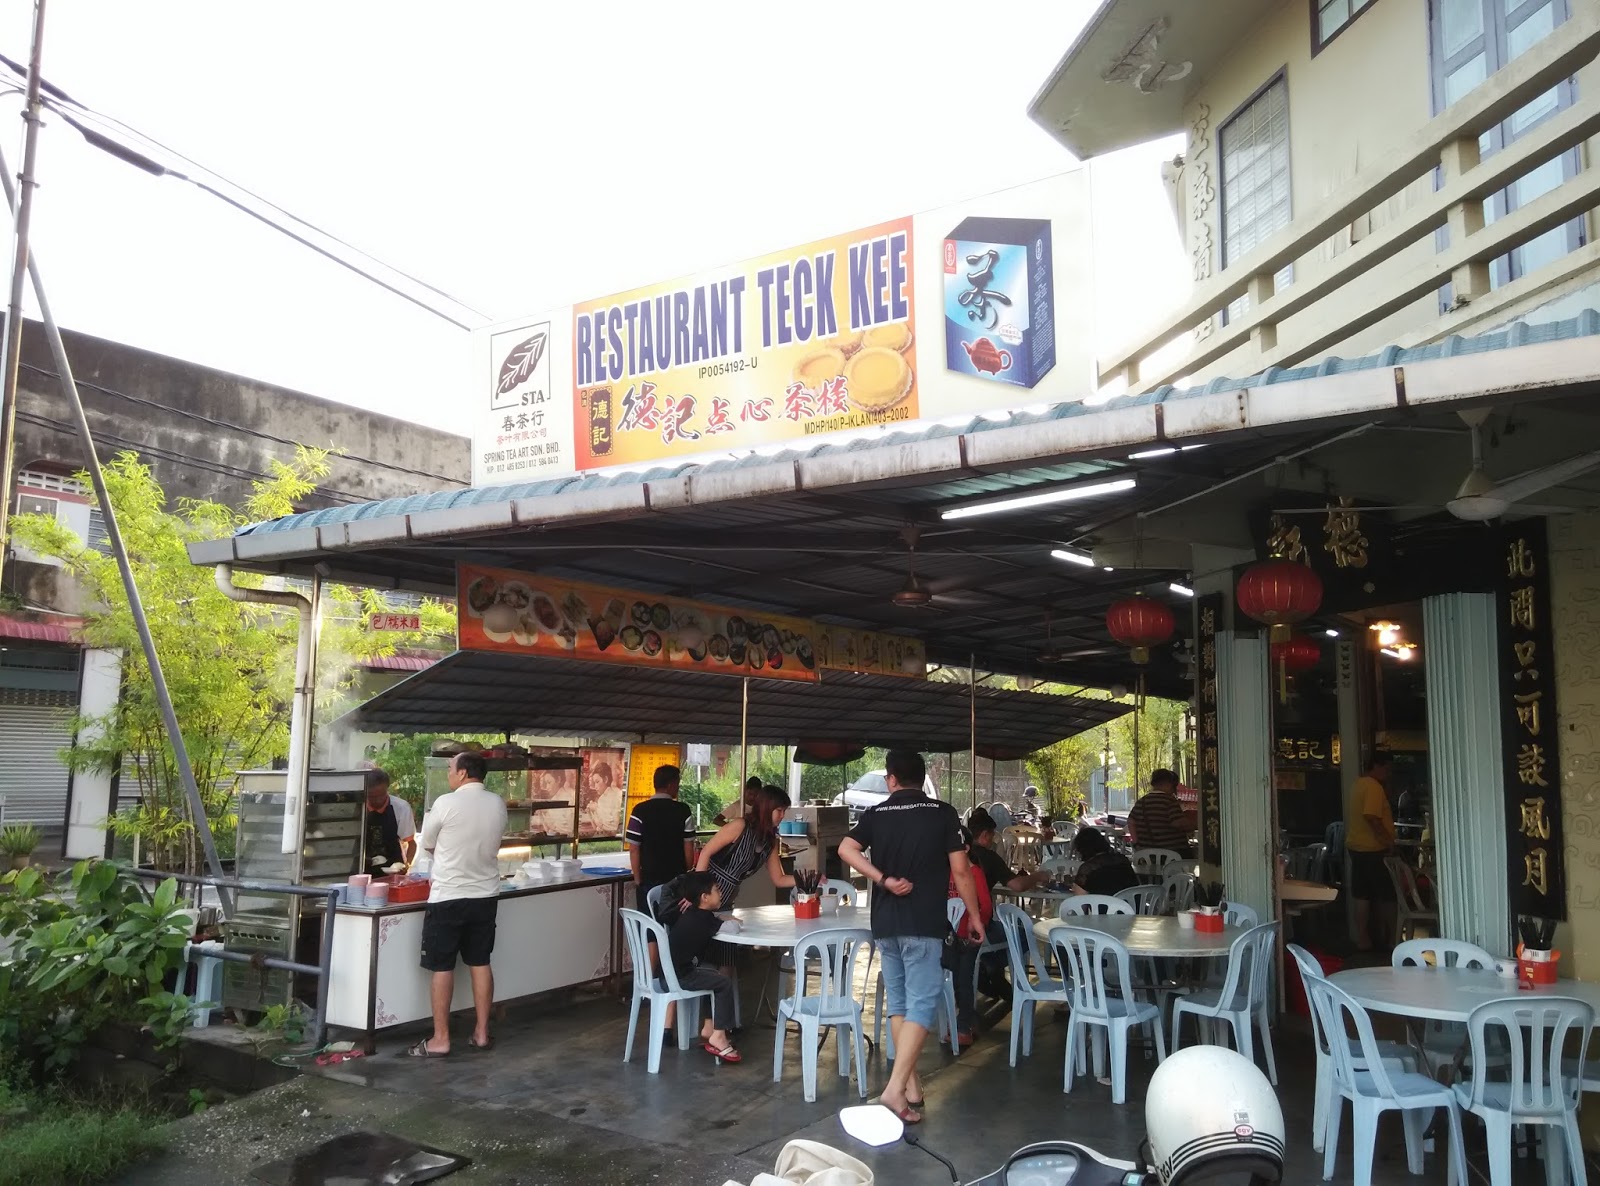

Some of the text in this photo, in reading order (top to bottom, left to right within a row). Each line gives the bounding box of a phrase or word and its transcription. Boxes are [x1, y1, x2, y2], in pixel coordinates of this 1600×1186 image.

[577, 234, 908, 386] RESTAURANT TECK KEE
[698, 356, 758, 379] IP0054192-U
[521, 389, 545, 406] STA
[502, 410, 545, 431] 春茶行
[497, 428, 547, 445] 茶叶有限公司
[484, 441, 561, 464] SPRING TEA ART SDN. BHD.
[1507, 537, 1551, 897] 此間只可談風月
